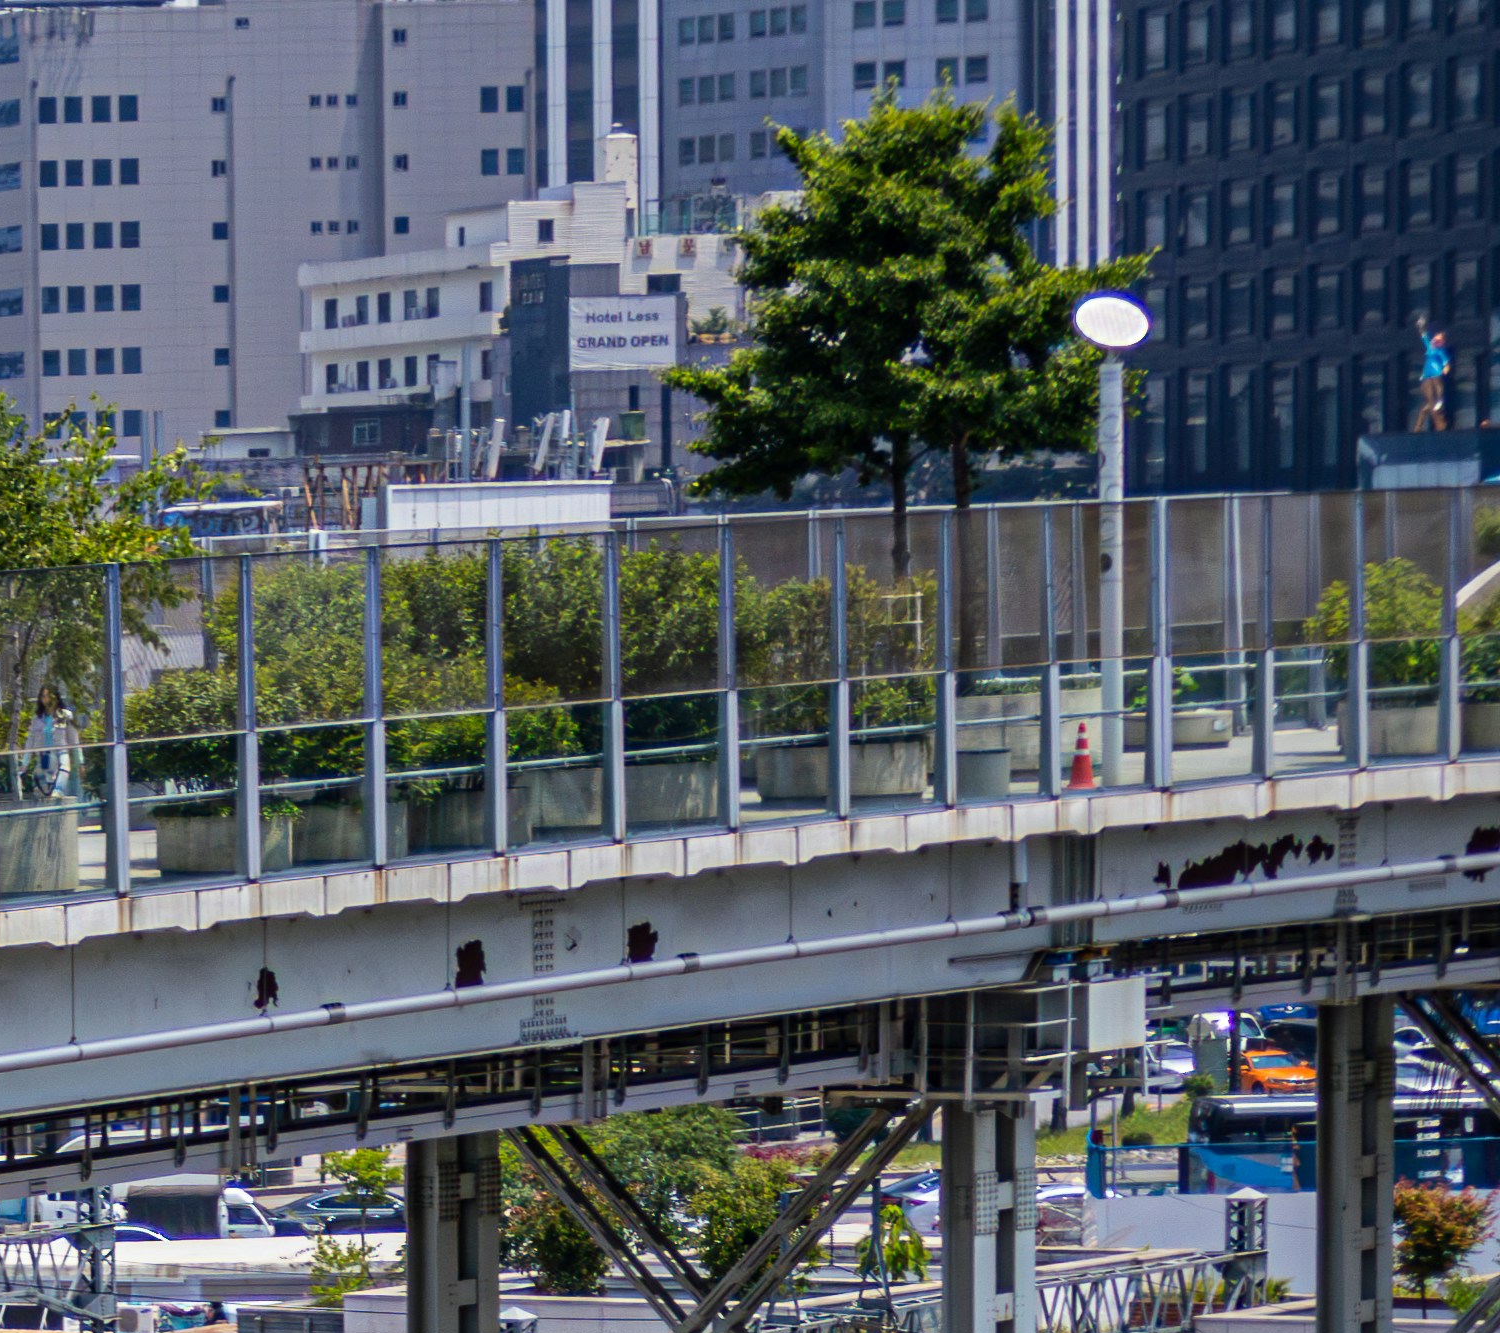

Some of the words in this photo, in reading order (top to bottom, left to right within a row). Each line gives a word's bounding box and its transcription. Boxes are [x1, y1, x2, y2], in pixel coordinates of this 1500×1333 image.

[585, 312, 623, 324] Hotel
[576, 335, 627, 349] GRAND
[630, 334, 670, 347] OPEN
